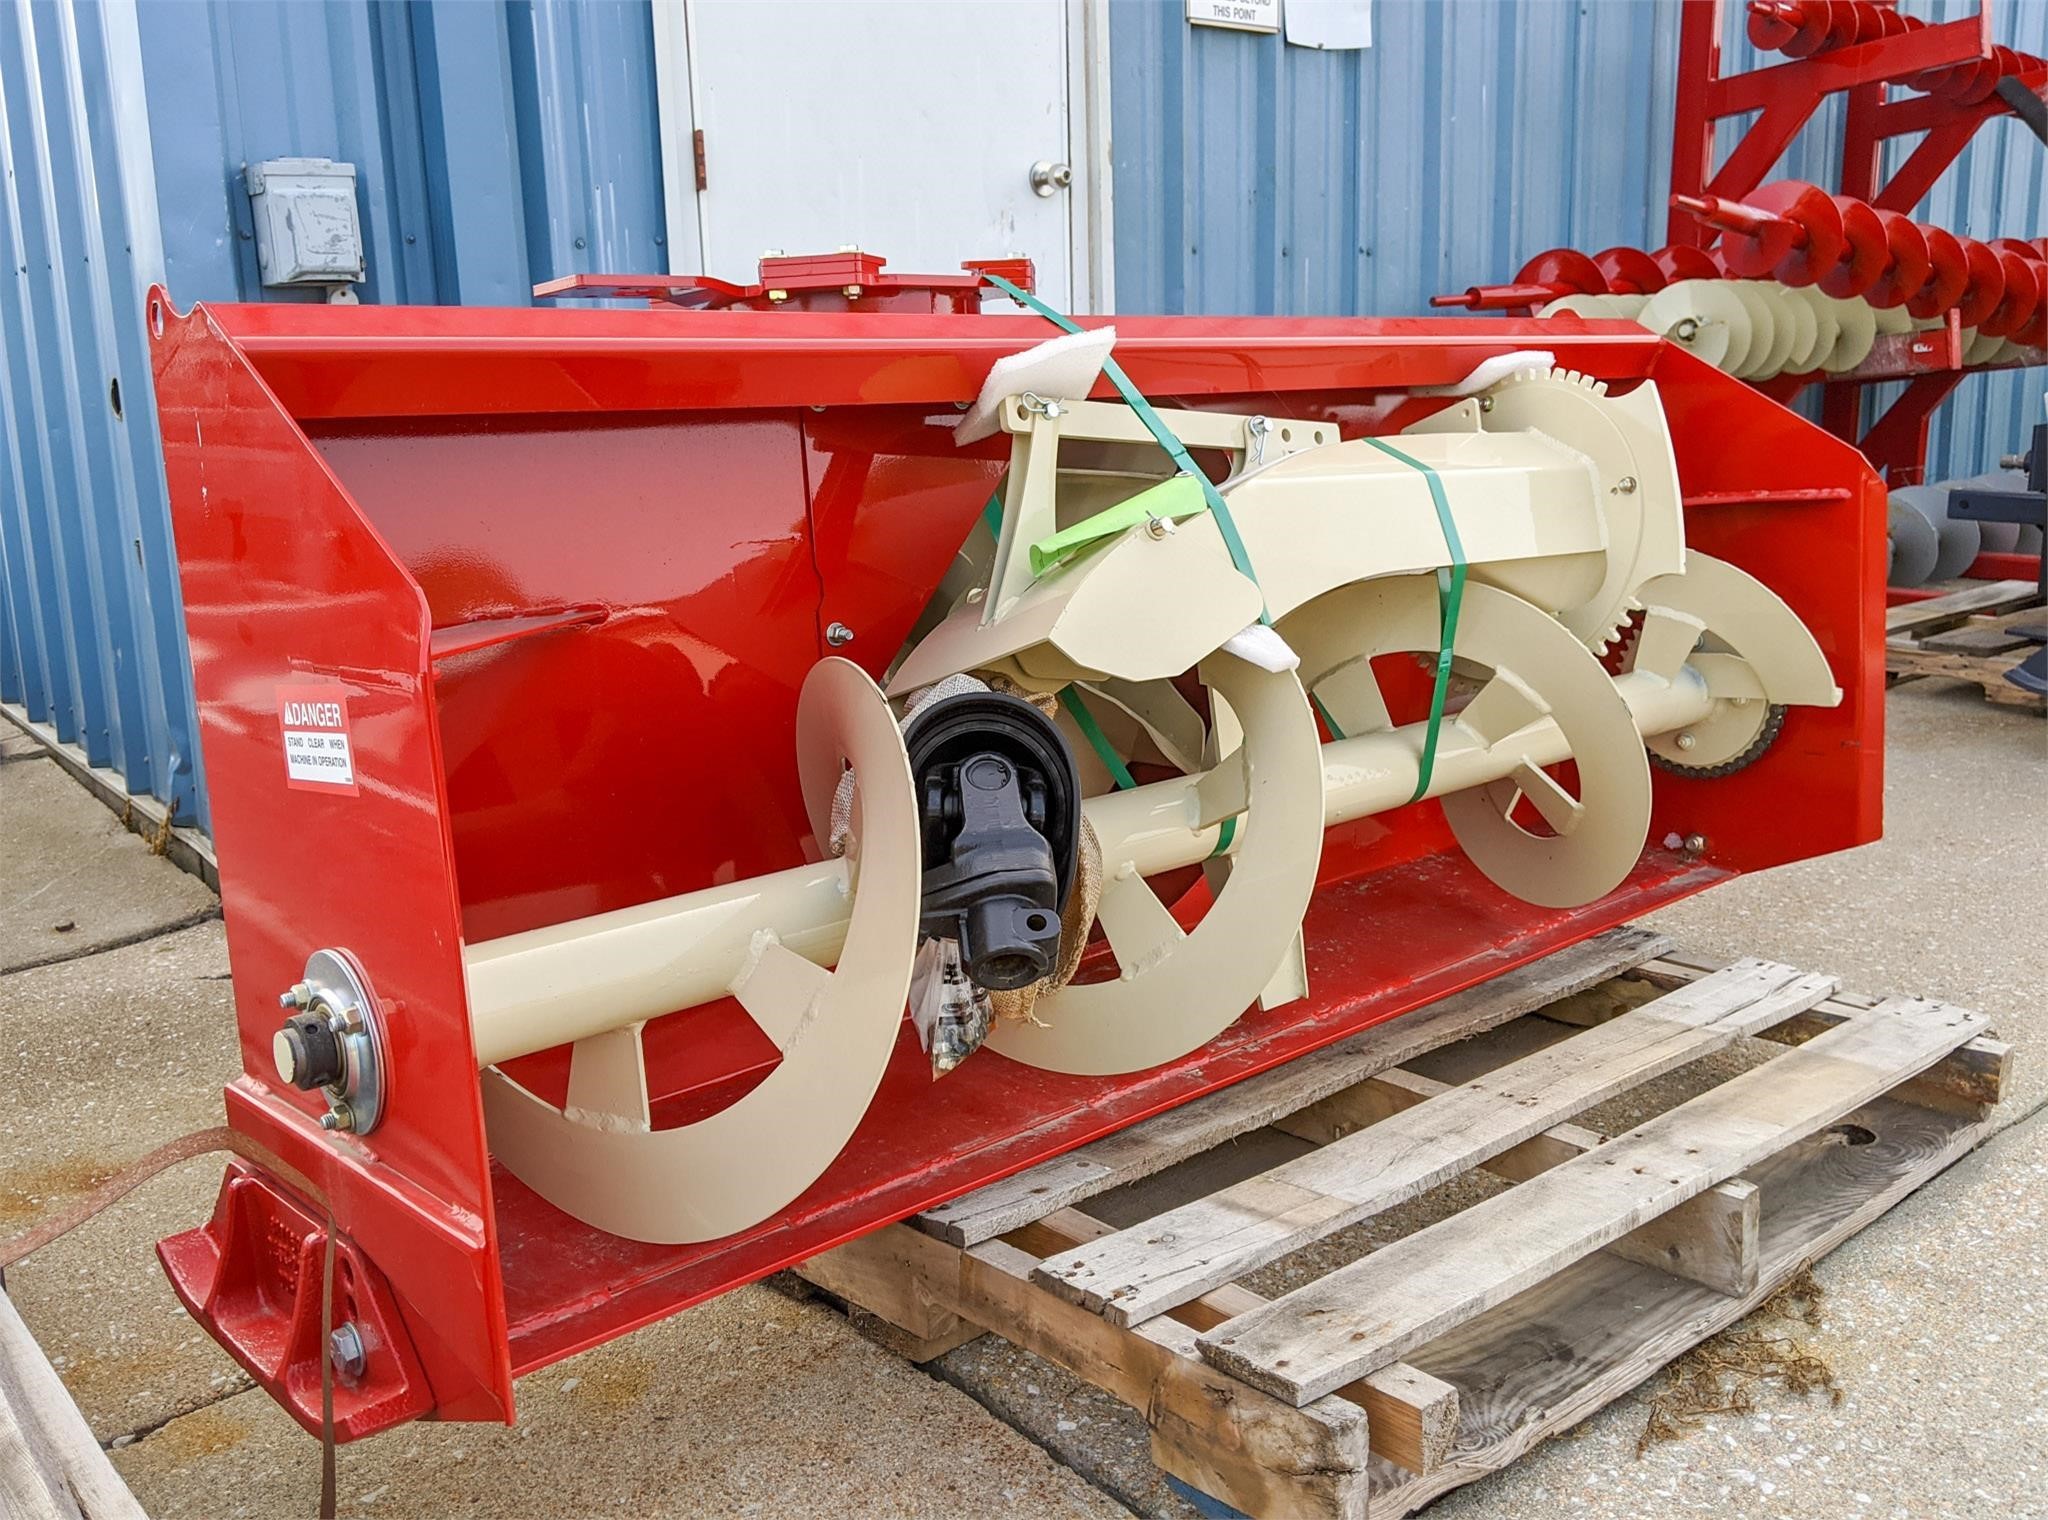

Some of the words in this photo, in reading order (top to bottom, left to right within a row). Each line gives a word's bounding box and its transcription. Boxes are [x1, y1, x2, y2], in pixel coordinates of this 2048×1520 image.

[1213, 5, 1230, 18] THIS
[1233, 7, 1256, 20] POINT
[292, 703, 342, 727] DANGER
[288, 737, 303, 747] STAND
[308, 738, 325, 748] CLEAR
[329, 739, 345, 750] WHEN
[290, 754, 312, 765] MACHINE
[312, 756, 318, 766] IN
[318, 756, 347, 768] OPERATION
